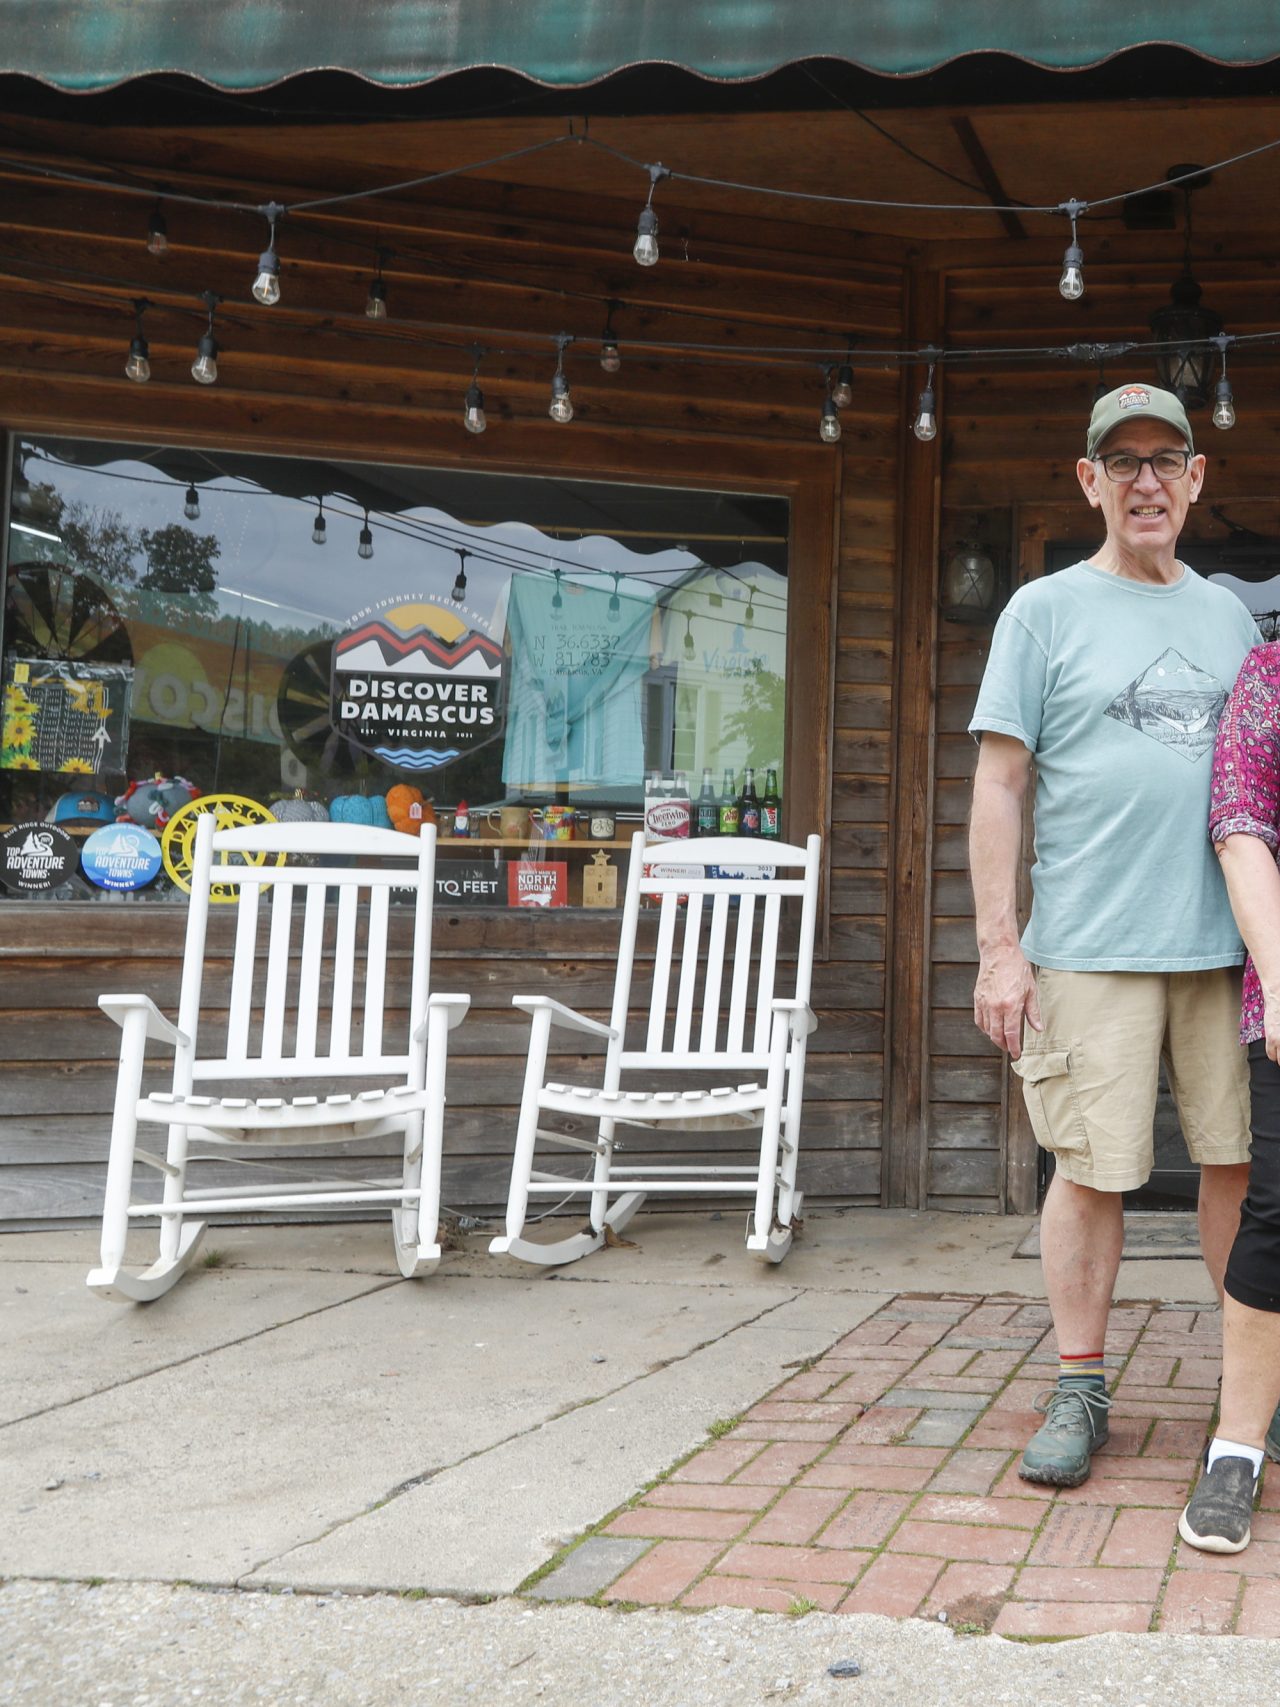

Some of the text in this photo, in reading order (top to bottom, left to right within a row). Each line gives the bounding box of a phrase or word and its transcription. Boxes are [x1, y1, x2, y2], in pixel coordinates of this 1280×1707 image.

[345, 606, 372, 627] YOUR
[375, 592, 424, 610] JOURNEY
[534, 635, 545, 650] N
[533, 653, 545, 667] W
[350, 679, 488, 703] DISCOVER
[341, 701, 494, 725] DAMASCUS
[388, 728, 447, 738] VIRGINIA
[648, 808, 689, 825] Cheerwine
[3, 821, 71, 841] BLUE RIDGE OUTDOORS
[6, 846, 21, 857] TOP
[6, 856, 66, 870] ADVENTURE
[95, 856, 151, 871] ADVENTURE
[21, 869, 48, 879] TOWNS
[108, 869, 134, 879] TOWNS
[518, 874, 557, 885] NORTH
[18, 880, 51, 889] WINNER!
[103, 879, 135, 888] WINNER
[463, 880, 499, 894] FEET
[518, 883, 557, 892] CAROLINA
